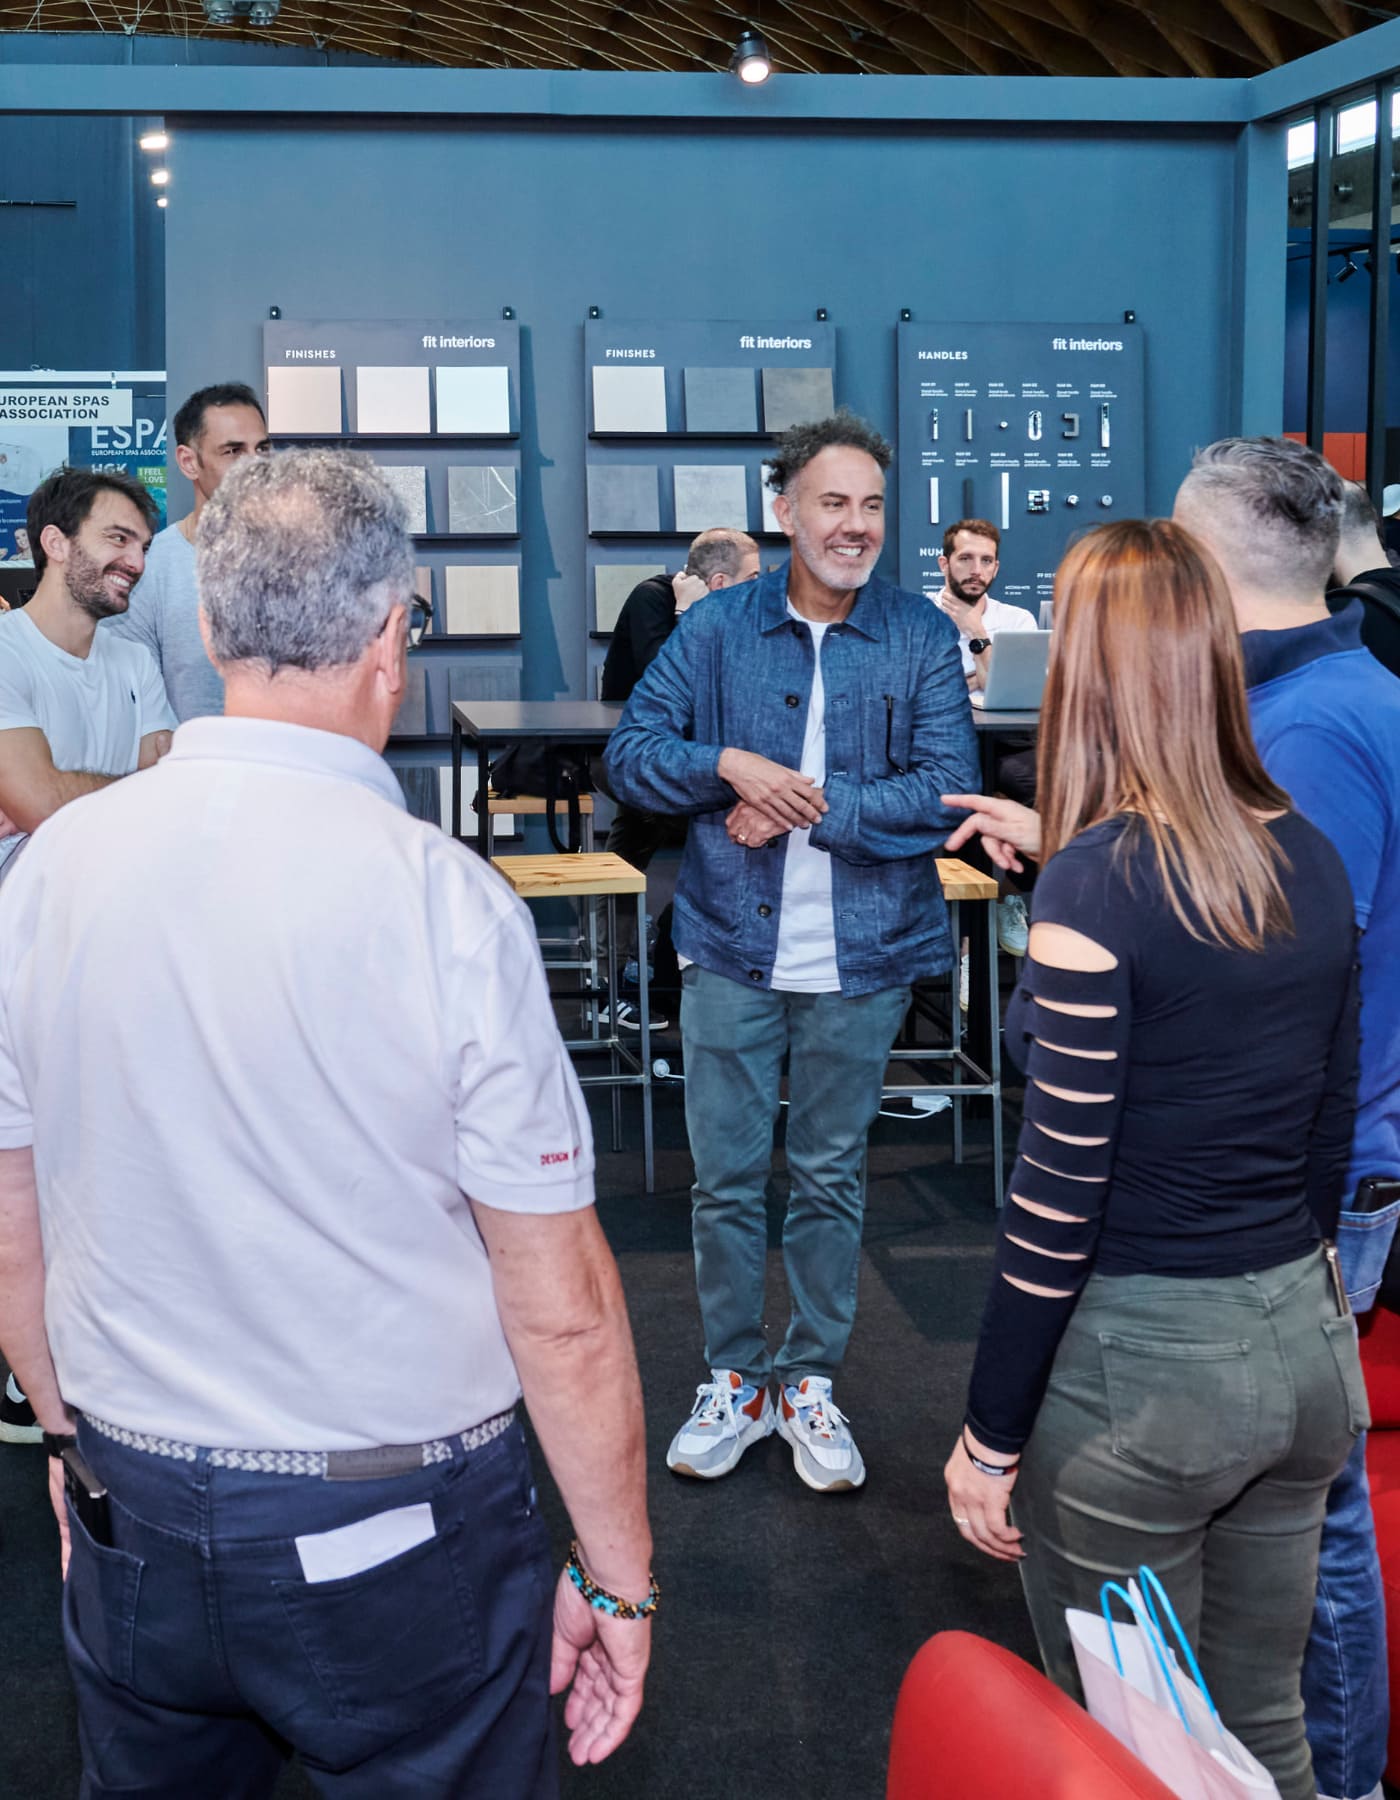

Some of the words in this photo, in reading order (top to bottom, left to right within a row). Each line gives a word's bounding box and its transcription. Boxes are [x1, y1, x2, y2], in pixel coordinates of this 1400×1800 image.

[422, 335, 436, 348] fit
[440, 335, 495, 348] interiors
[740, 336, 755, 349] fit
[757, 336, 812, 349] interiors
[1052, 338, 1067, 351] fit
[1069, 338, 1123, 351] interiors
[285, 350, 336, 359] FINISHES
[606, 349, 656, 358] FINISHES
[918, 351, 968, 360] HANDLES
[73, 396, 110, 406] SPAS
[0, 409, 98, 419] ASSOCIATION
